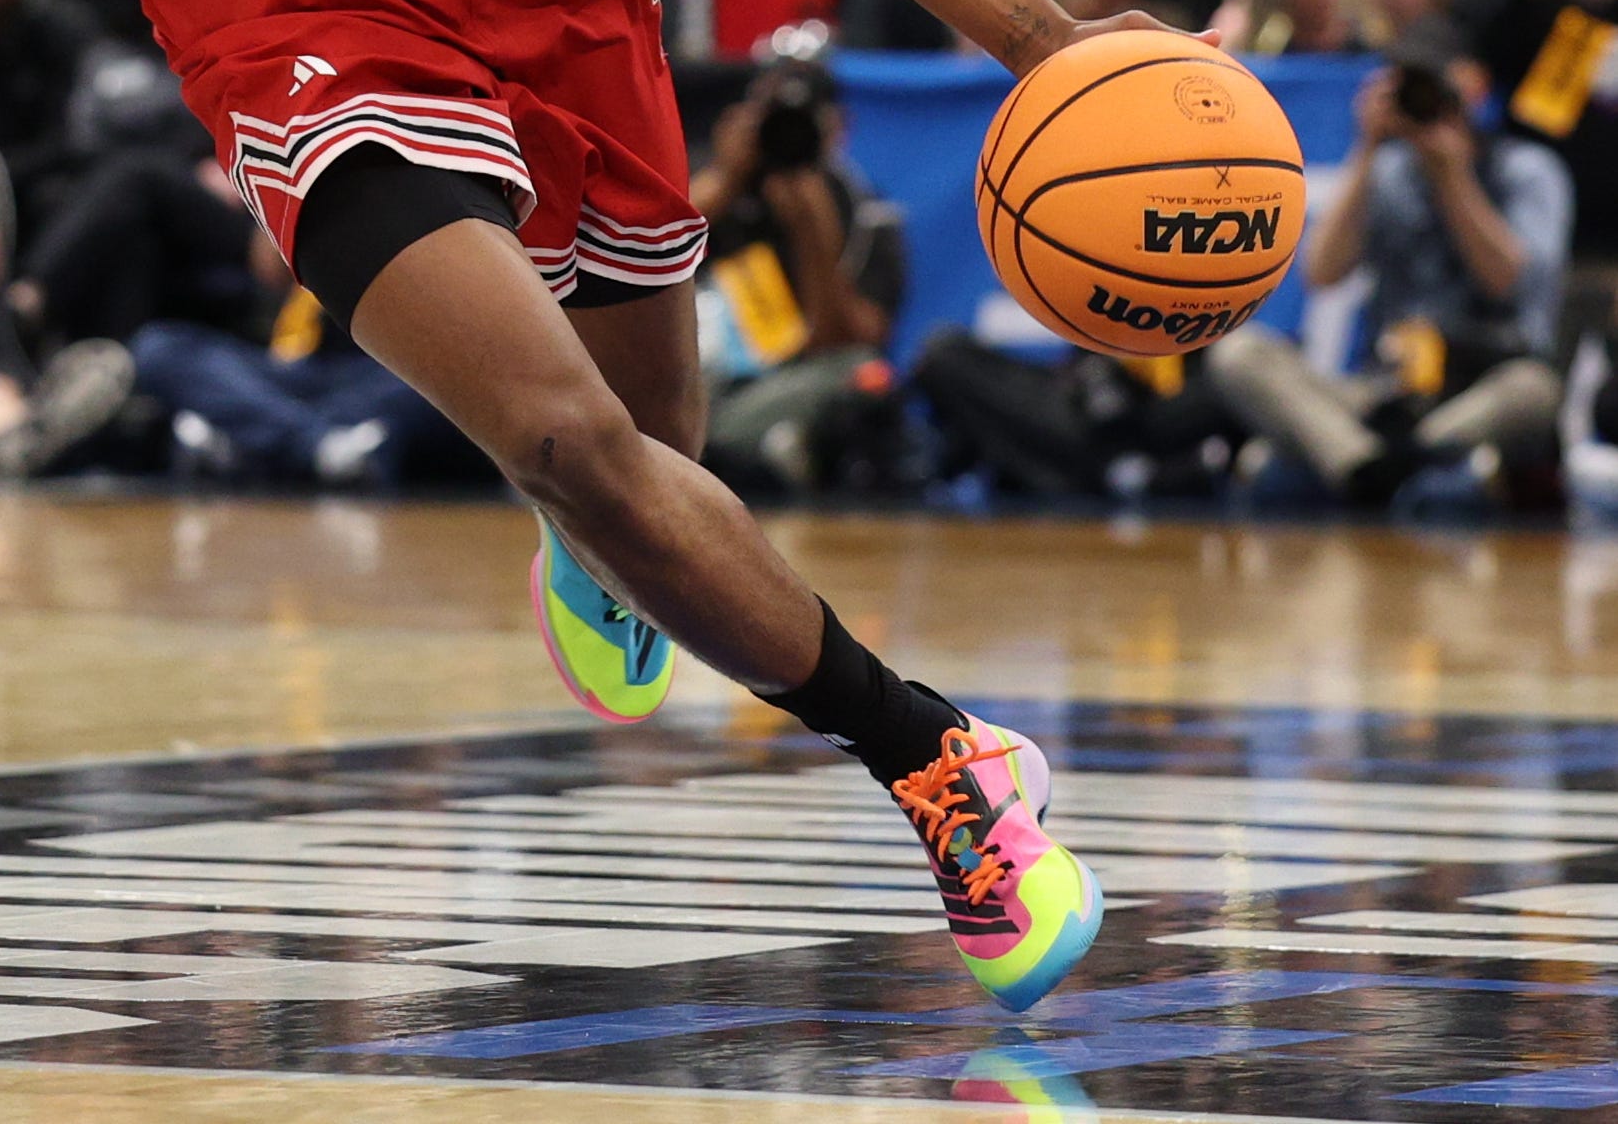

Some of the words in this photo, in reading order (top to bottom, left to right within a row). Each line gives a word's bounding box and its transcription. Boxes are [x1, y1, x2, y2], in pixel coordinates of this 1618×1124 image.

[1145, 194, 1187, 205] BALL
[1191, 195, 1232, 206] GAME
[1144, 206, 1281, 255] NCAA
[1086, 284, 1273, 345] Wilson
